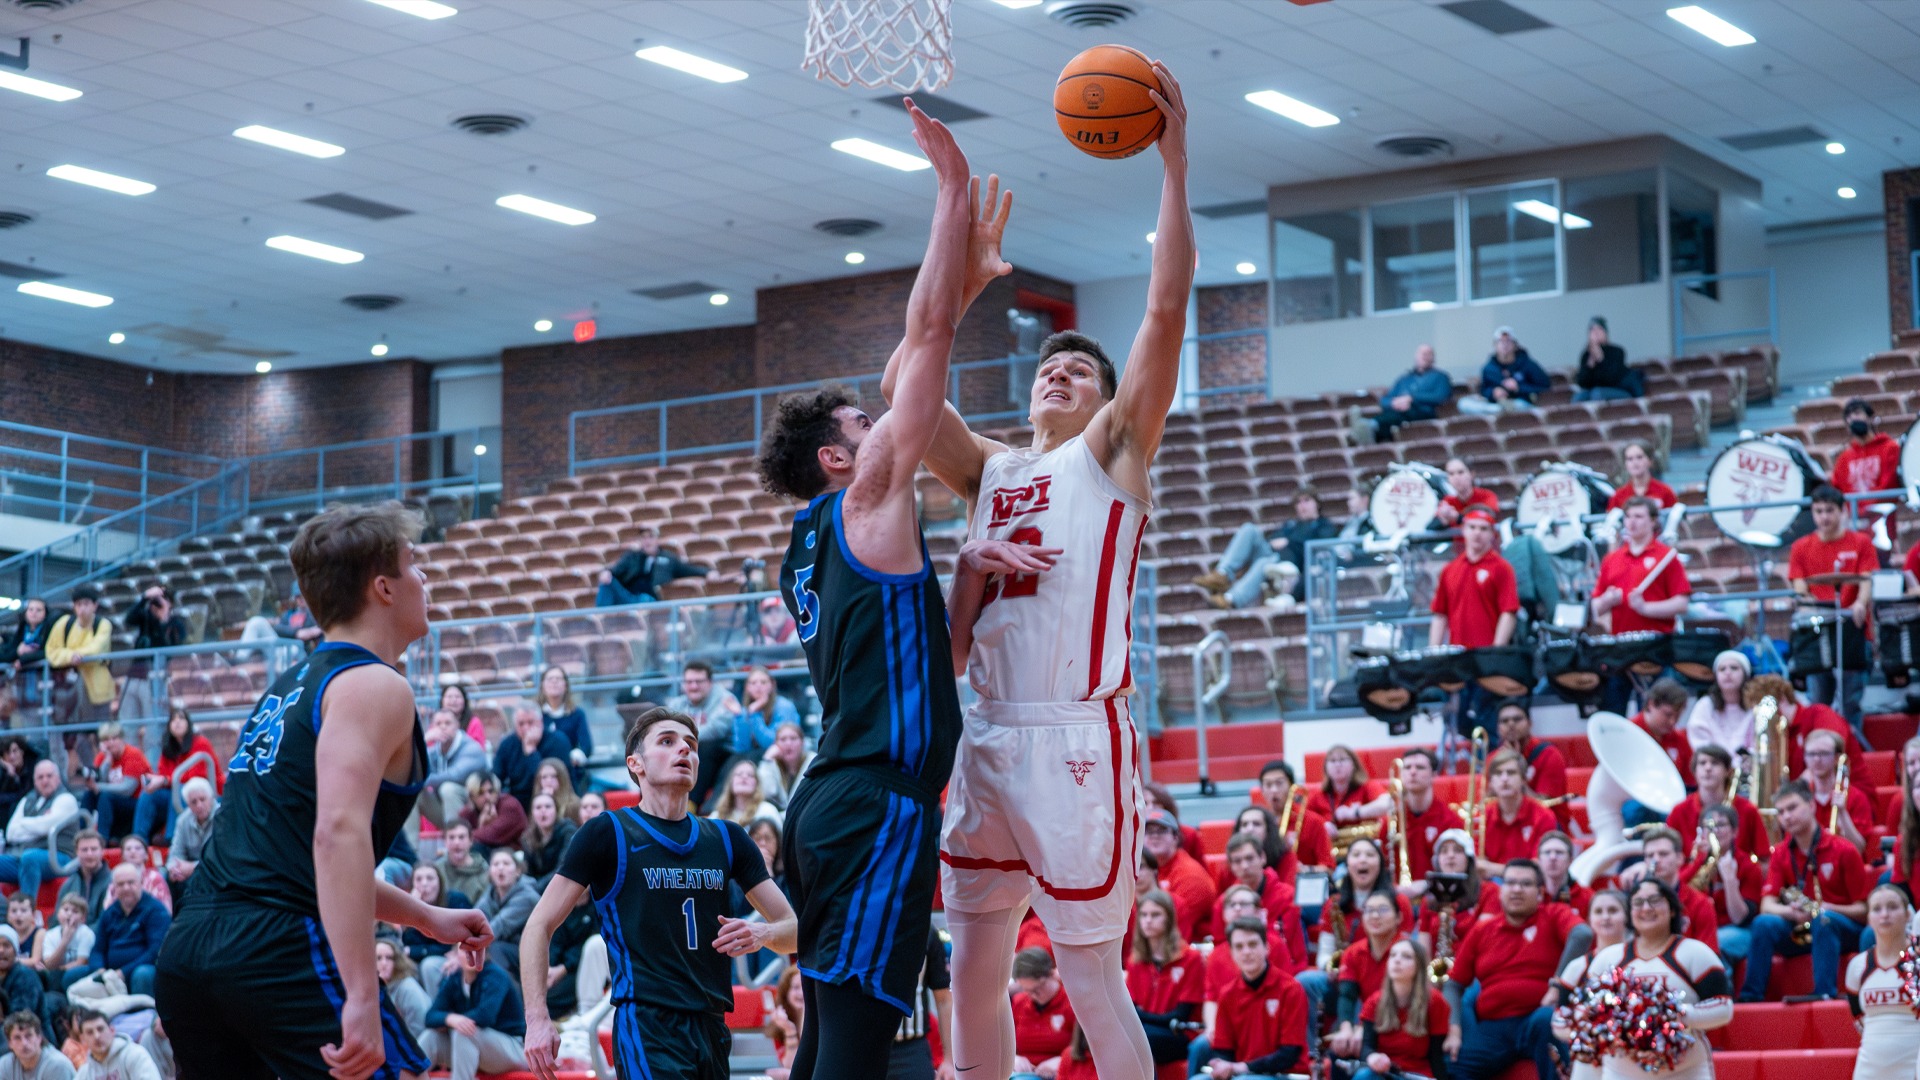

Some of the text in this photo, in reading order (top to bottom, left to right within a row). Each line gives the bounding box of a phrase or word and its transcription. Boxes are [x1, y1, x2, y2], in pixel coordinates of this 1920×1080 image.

[1077, 130, 1119, 145] EVO
[1737, 451, 1790, 481] WPI
[1532, 477, 1575, 500] WPI
[792, 563, 820, 643] 5
[228, 686, 305, 776] 25
[642, 867, 724, 890] WHEATON
[681, 897, 698, 950] 1
